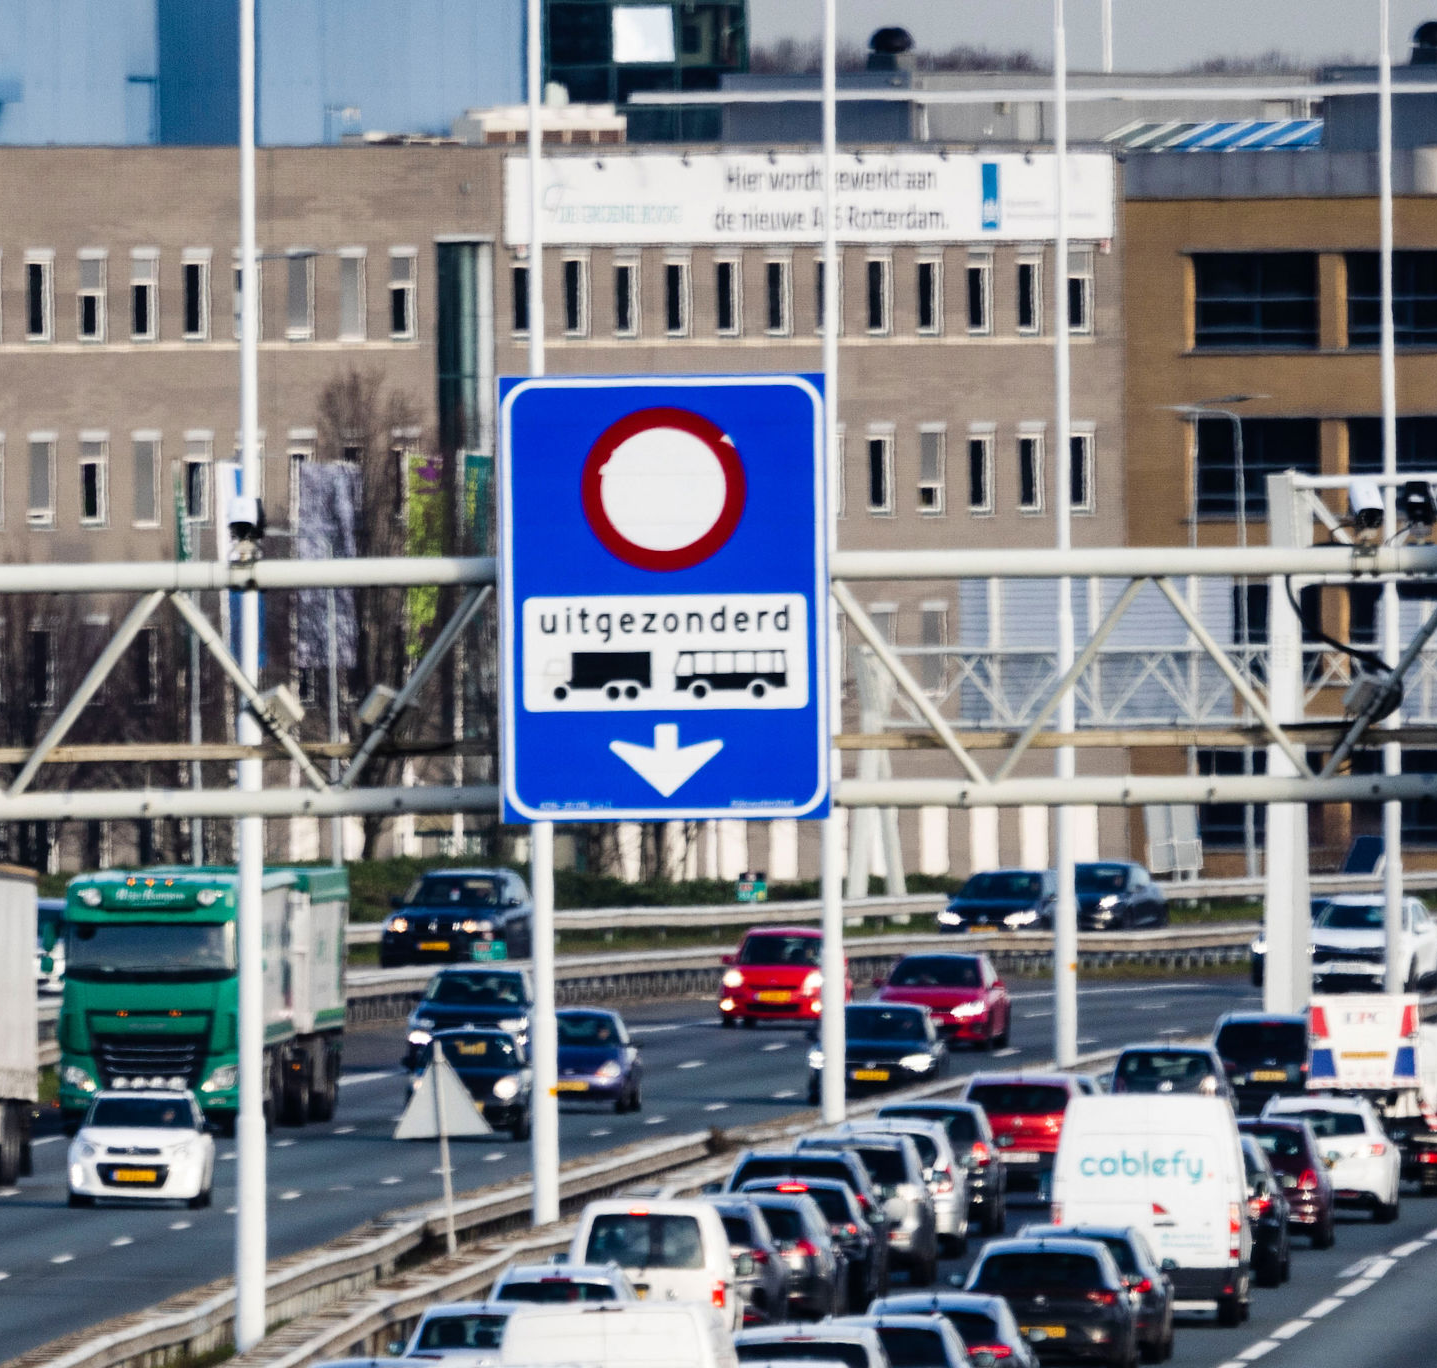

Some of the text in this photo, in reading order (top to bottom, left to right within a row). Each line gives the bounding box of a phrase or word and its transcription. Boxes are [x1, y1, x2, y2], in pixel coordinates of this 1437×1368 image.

[727, 167, 762, 191] Hier
[742, 206, 806, 231] nieuwe
[539, 605, 791, 642] uitgezonderd
